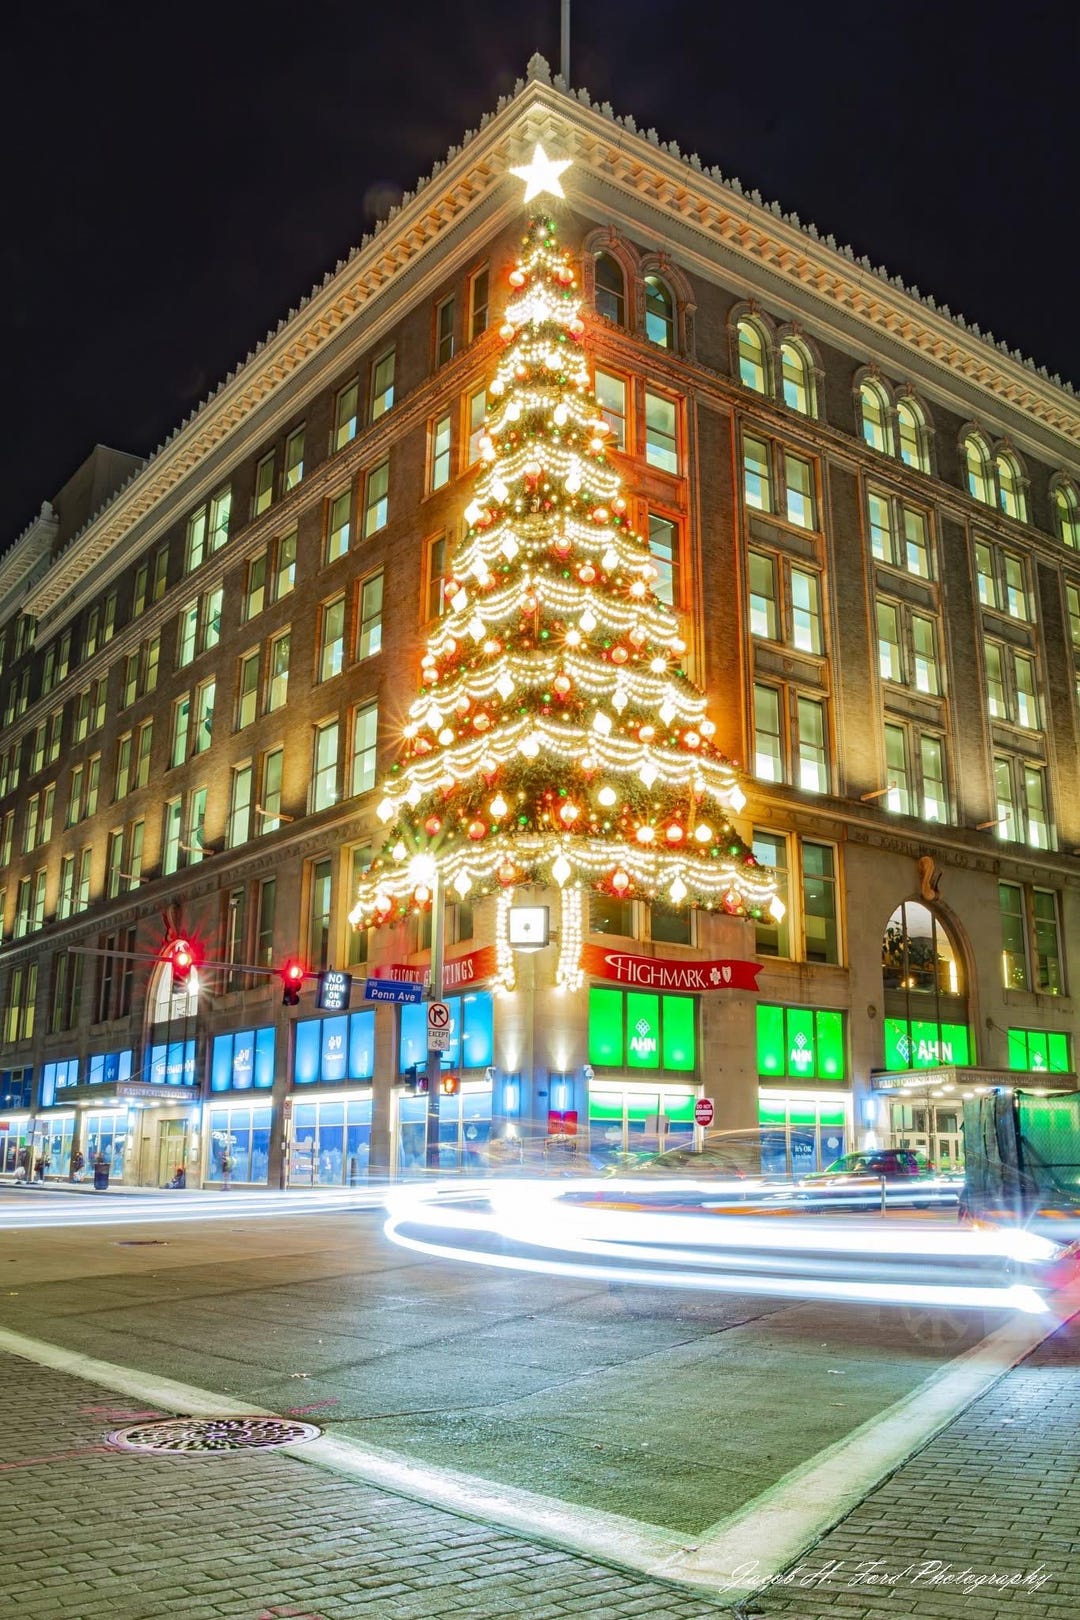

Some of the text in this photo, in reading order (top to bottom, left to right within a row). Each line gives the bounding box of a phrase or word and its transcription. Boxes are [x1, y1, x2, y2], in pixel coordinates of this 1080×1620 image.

[328, 973, 343, 983] NO
[324, 983, 346, 992] TURN
[328, 991, 340, 1000] ON
[371, 988, 416, 1002] Penn Ave
[325, 999, 341, 1008] RED
[428, 1030, 449, 1038] EXCEPT
[630, 1036, 657, 1052] AHN
[790, 1048, 813, 1062] AHN
[917, 1039, 953, 1062] AHN
